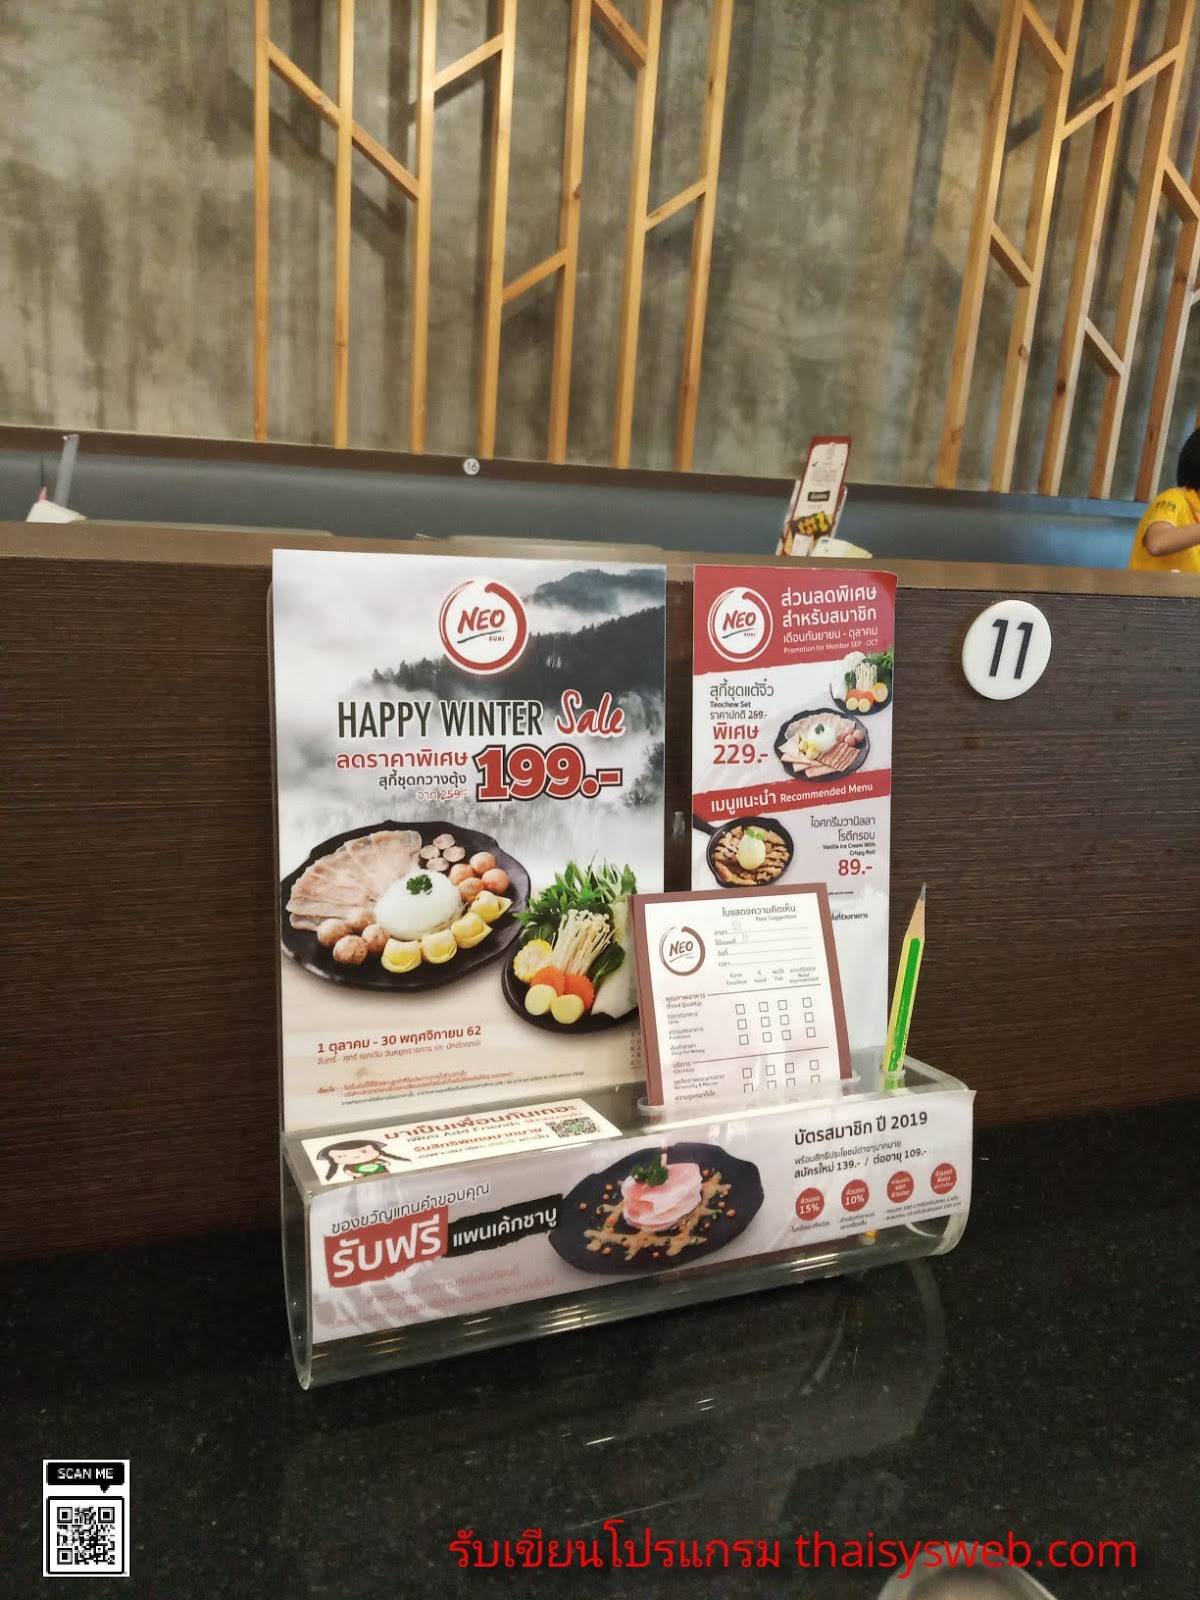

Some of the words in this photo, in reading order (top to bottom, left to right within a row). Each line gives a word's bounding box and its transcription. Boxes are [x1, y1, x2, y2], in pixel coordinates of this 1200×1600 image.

[781, 584, 878, 607] ส่วนลดพิเศษ
[457, 606, 506, 634] NEO
[722, 609, 757, 631] NEO
[782, 606, 877, 628] สำหรับสมาชิก
[783, 630, 841, 644] เดือนกันยายน
[848, 627, 878, 640] ตุลาคม
[783, 645, 816, 654] Promotion
[825, 642, 850, 650] Member
[850, 640, 863, 648] SEP
[988, 618, 1034, 680] 11
[710, 678, 775, 700] สุกี้ชุดแต้จิ๋ว
[337, 700, 432, 739] HAPPY
[439, 700, 544, 737] WINTER
[555, 688, 626, 736] Sale
[710, 710, 746, 720] ราคาปกติ
[713, 722, 760, 740] พิเศษ
[336, 748, 468, 769] ลดราคาพิเศษ
[713, 744, 769, 765] 229.-
[378, 769, 467, 790] สุกี้ชุดกวางตุ้ง
[474, 743, 623, 803] 199.-
[710, 789, 777, 815] เมนูแนะนำ
[780, 786, 847, 803] Recommended
[848, 783, 874, 793] Menu
[810, 815, 876, 829] ไอศกรีมวานิลลา
[838, 828, 876, 842] โรตีกรอบ
[838, 858, 873, 876] 89.-
[721, 903, 796, 918] ใบแสดงความคิดเห็น
[669, 940, 694, 957] NEO
[317, 1042, 325, 1053] 1
[328, 1038, 370, 1055] ตุลาคม
[381, 1034, 397, 1047] 30
[400, 1028, 464, 1045] พฤศจิกายน
[466, 1025, 482, 1036] 62
[794, 1119, 872, 1146] บัตรสมาชิก
[876, 1114, 887, 1133] ปี
[890, 1111, 929, 1130] 2019
[794, 1162, 835, 1179] สมัครใหม่
[836, 1160, 861, 1171] 139.-
[873, 1152, 902, 1164] ต่ออายุ
[904, 1147, 928, 1159] 109.-
[331, 1181, 492, 1234] ของขวัญแทนคำขอบคุณ
[800, 1202, 820, 1215] 15%
[845, 1194, 865, 1206] 10%
[331, 1213, 442, 1278] รับฟรี
[452, 1207, 558, 1248] แพนเค้กชาบู
